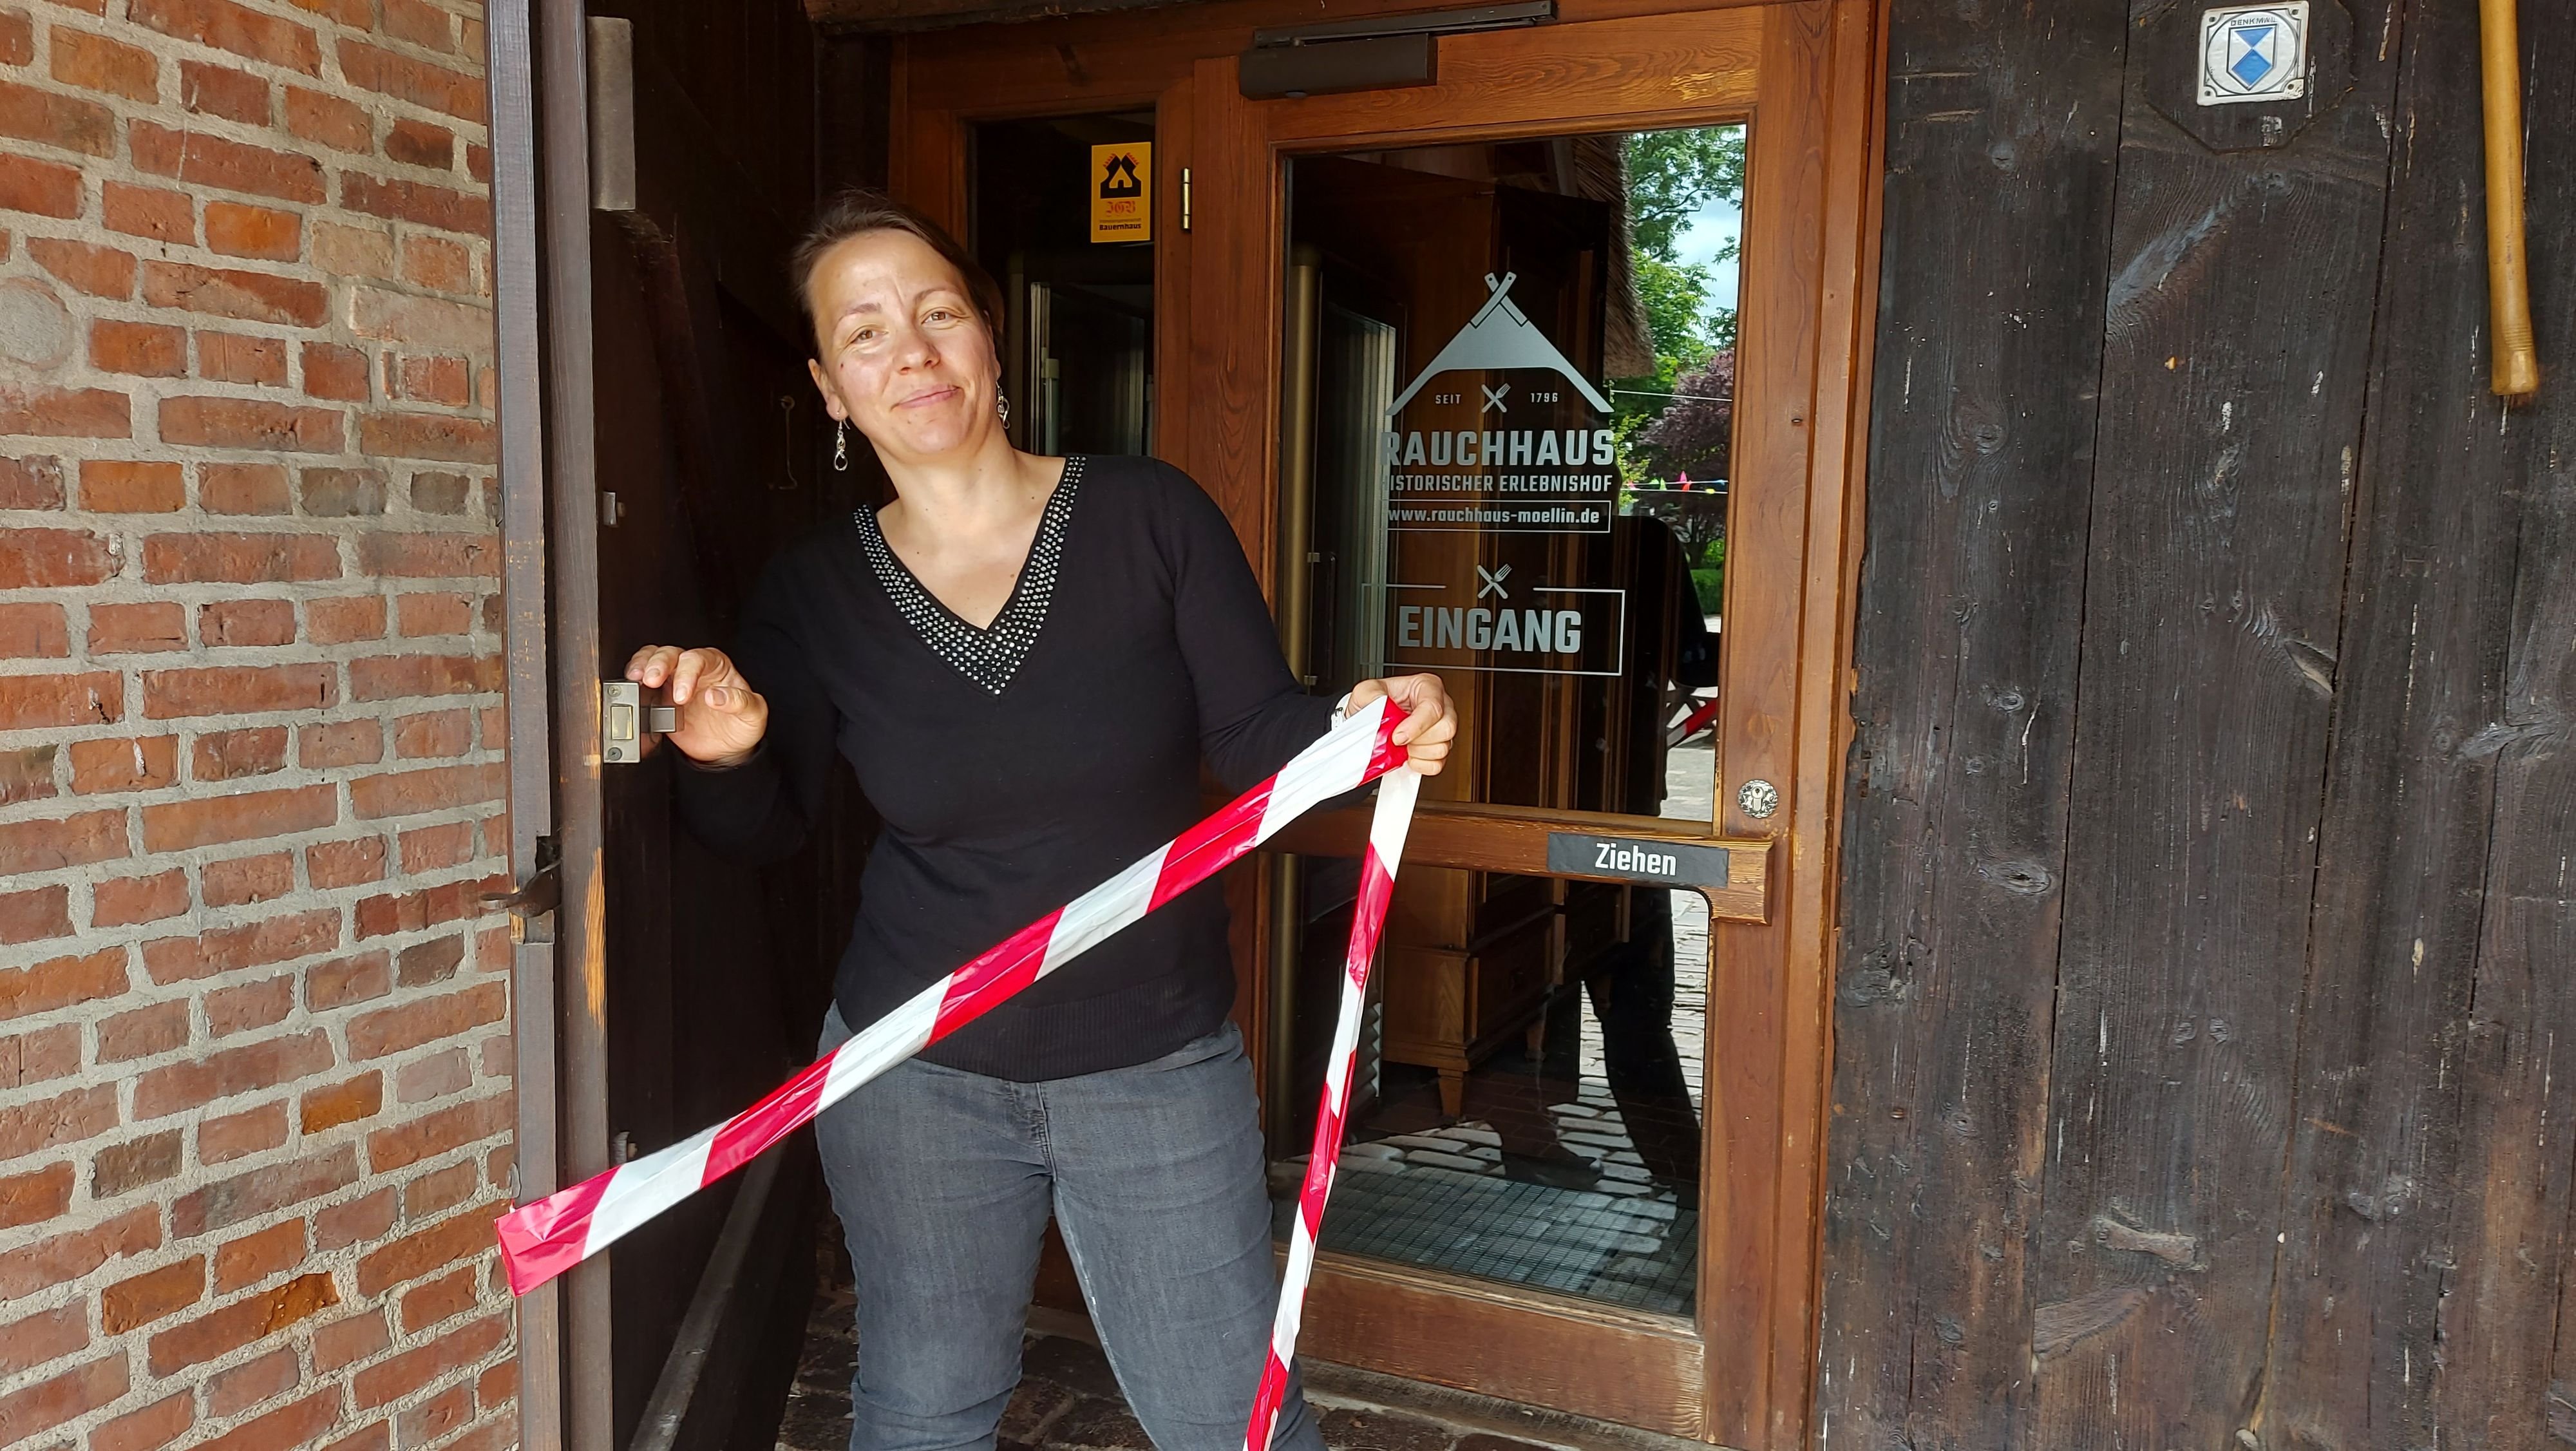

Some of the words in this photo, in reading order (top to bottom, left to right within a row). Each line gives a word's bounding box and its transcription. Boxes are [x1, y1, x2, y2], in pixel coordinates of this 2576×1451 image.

[2231, 17, 2277, 26] DENKMAL
[1435, 394, 1462, 405] SEIT
[1531, 392, 1558, 403] 1796
[1380, 429, 1615, 466] RAUCHHAUS
[1499, 475, 1613, 492] ERLEBNISHOF
[1388, 506, 1600, 524] www.rauchhaus-moellin.de
[1398, 605, 1581, 653] EINGANG
[1595, 842, 1676, 876] Ziehen
